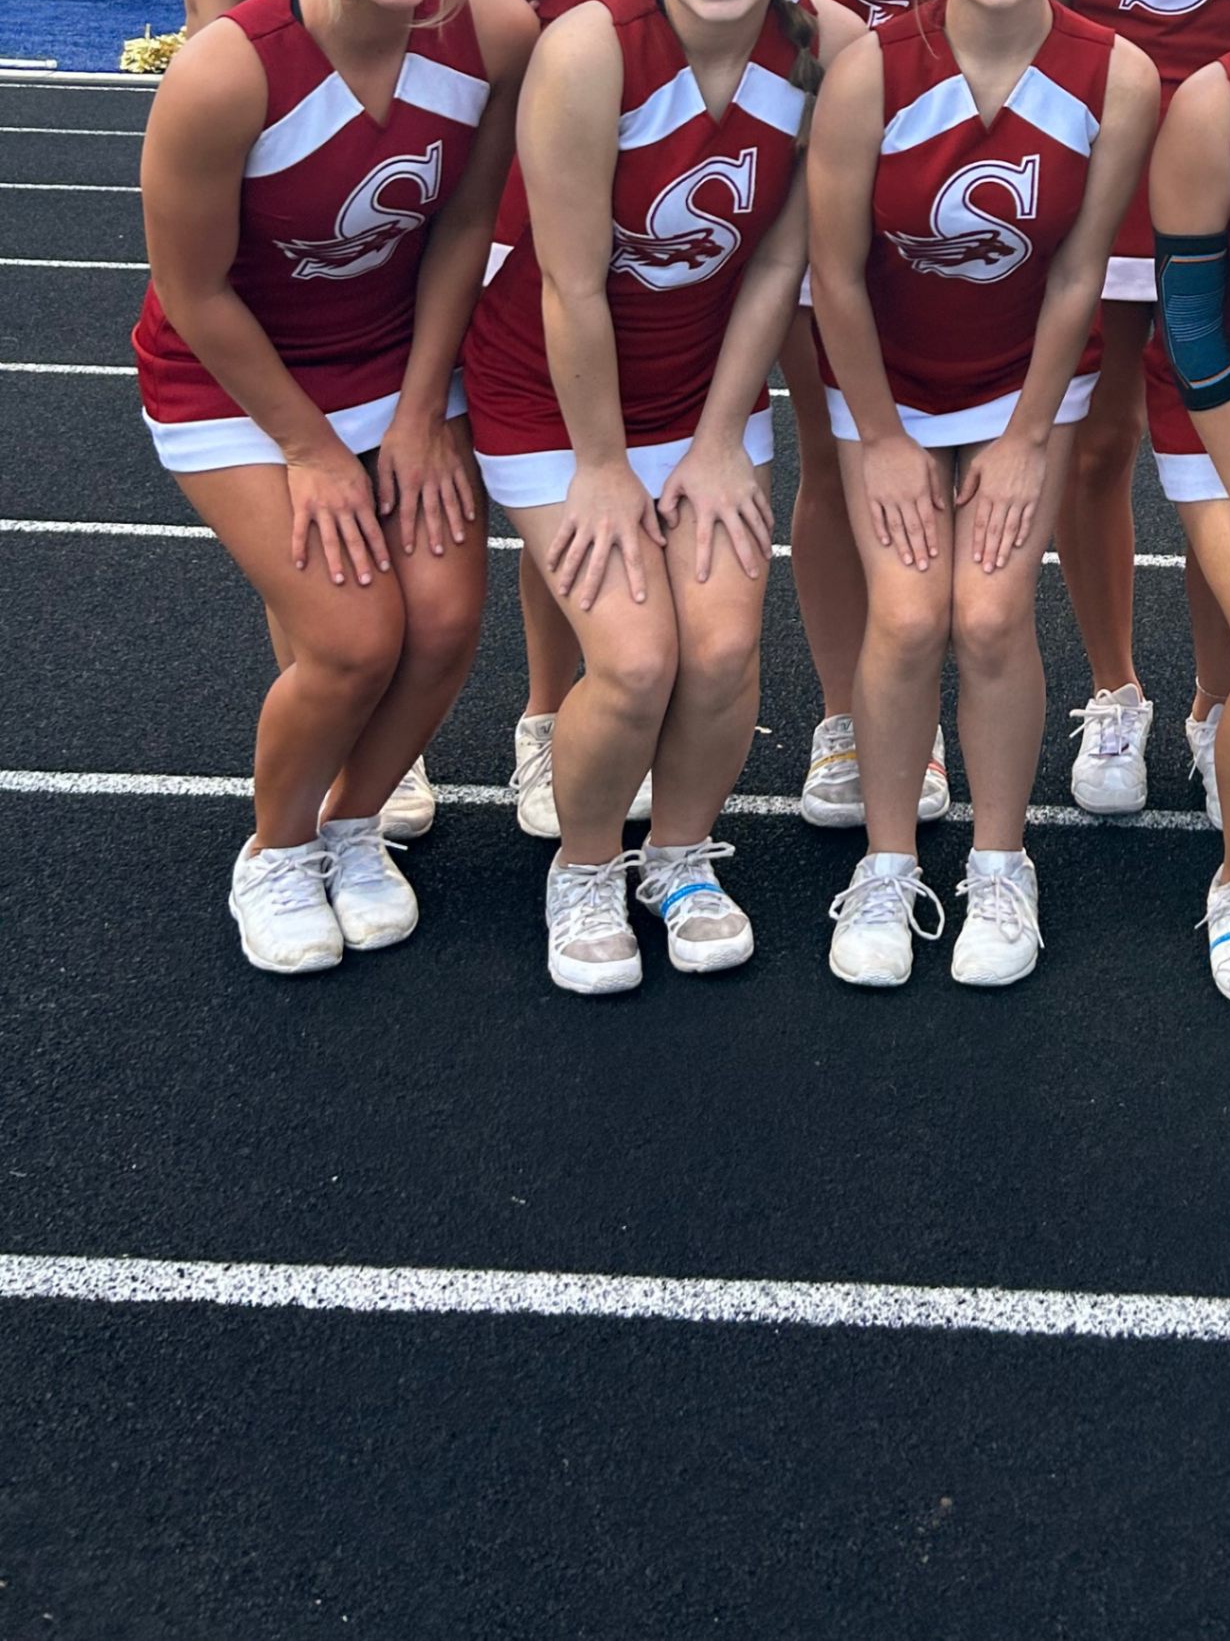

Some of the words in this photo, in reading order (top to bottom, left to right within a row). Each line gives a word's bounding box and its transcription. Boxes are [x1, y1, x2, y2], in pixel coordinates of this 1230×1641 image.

[292, 139, 443, 280] S
[610, 146, 759, 292] S
[909, 154, 1042, 284] S
